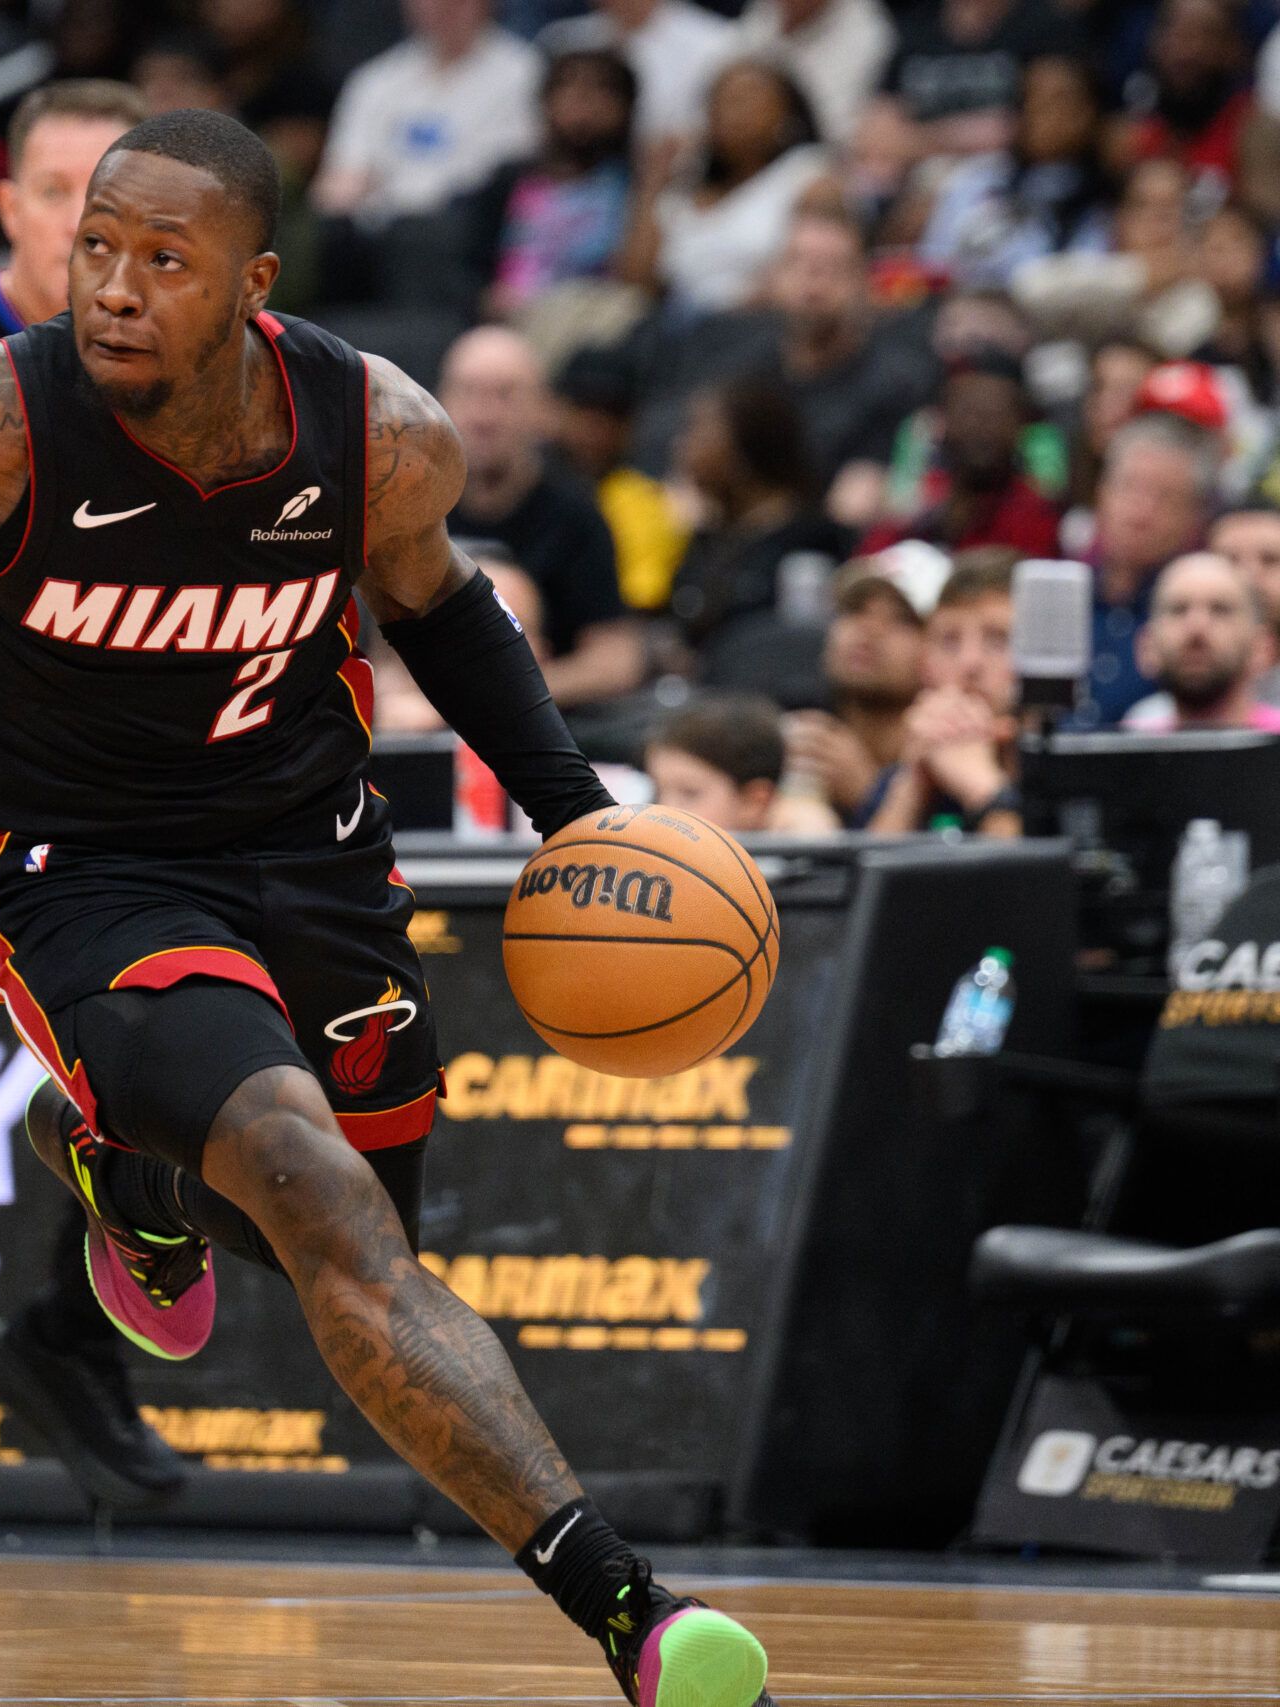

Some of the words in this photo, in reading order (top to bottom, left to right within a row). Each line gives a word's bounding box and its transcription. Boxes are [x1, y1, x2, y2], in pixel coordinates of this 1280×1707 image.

[250, 528, 333, 542] Robinhood
[21, 568, 341, 653] MIAMI
[206, 649, 295, 744] 2
[518, 864, 674, 924] Wilson
